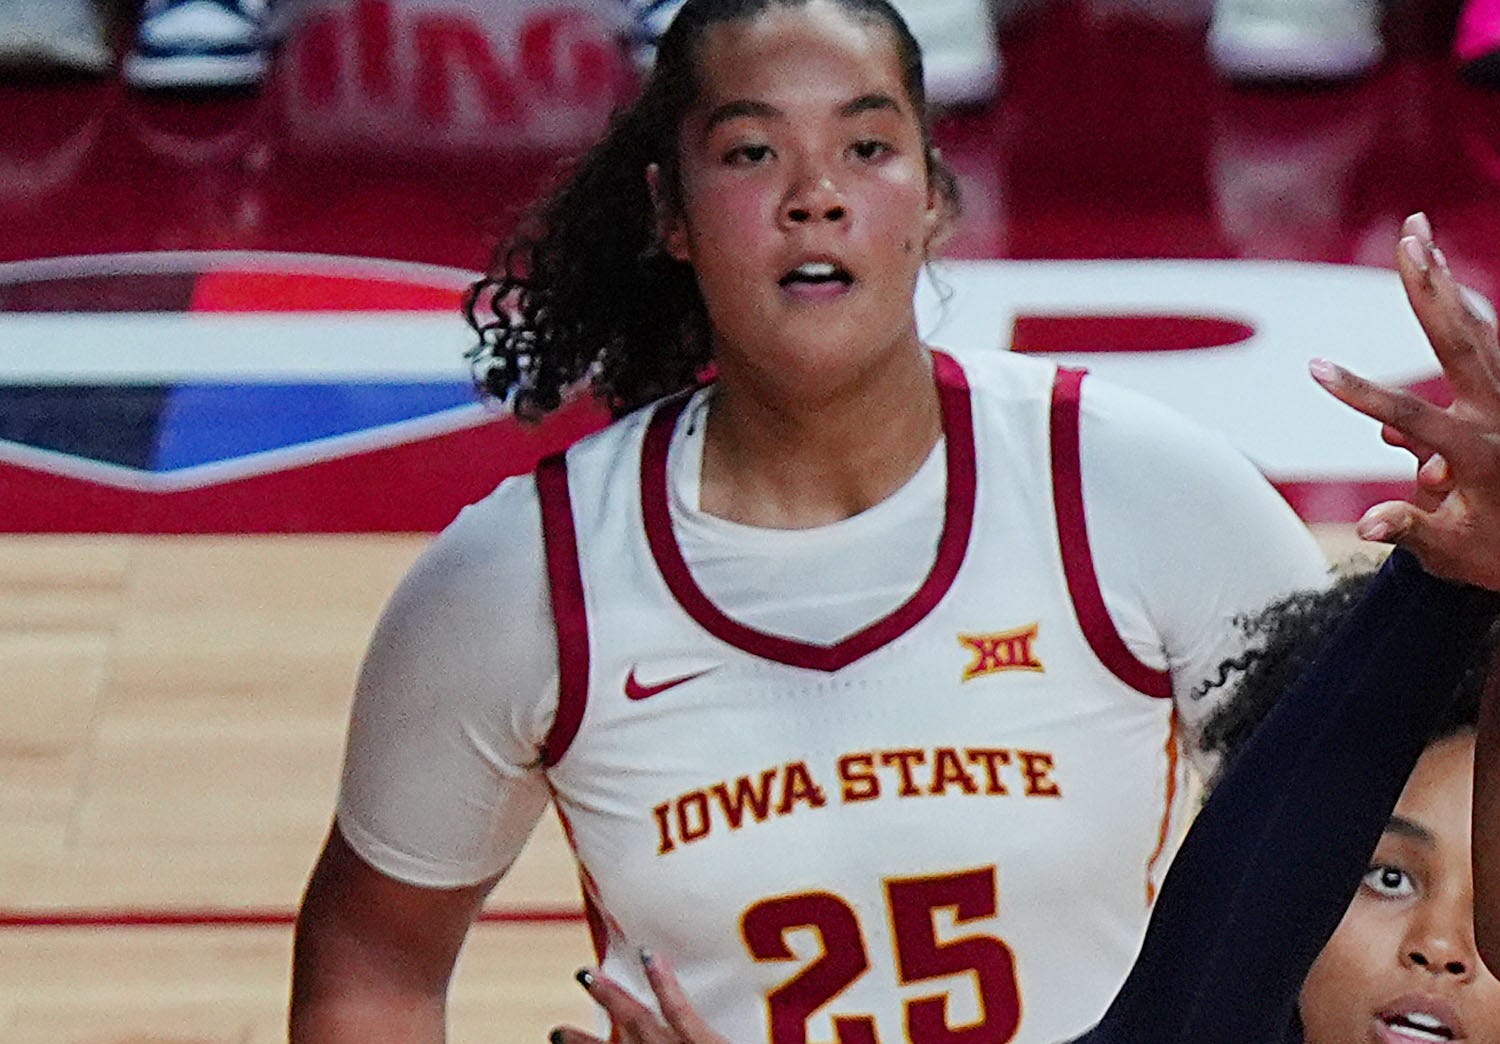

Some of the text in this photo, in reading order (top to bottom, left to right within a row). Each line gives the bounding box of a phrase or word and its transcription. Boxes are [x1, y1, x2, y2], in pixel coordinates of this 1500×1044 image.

[956, 622, 1045, 683] XII
[652, 747, 1063, 856] IOWA STATE
